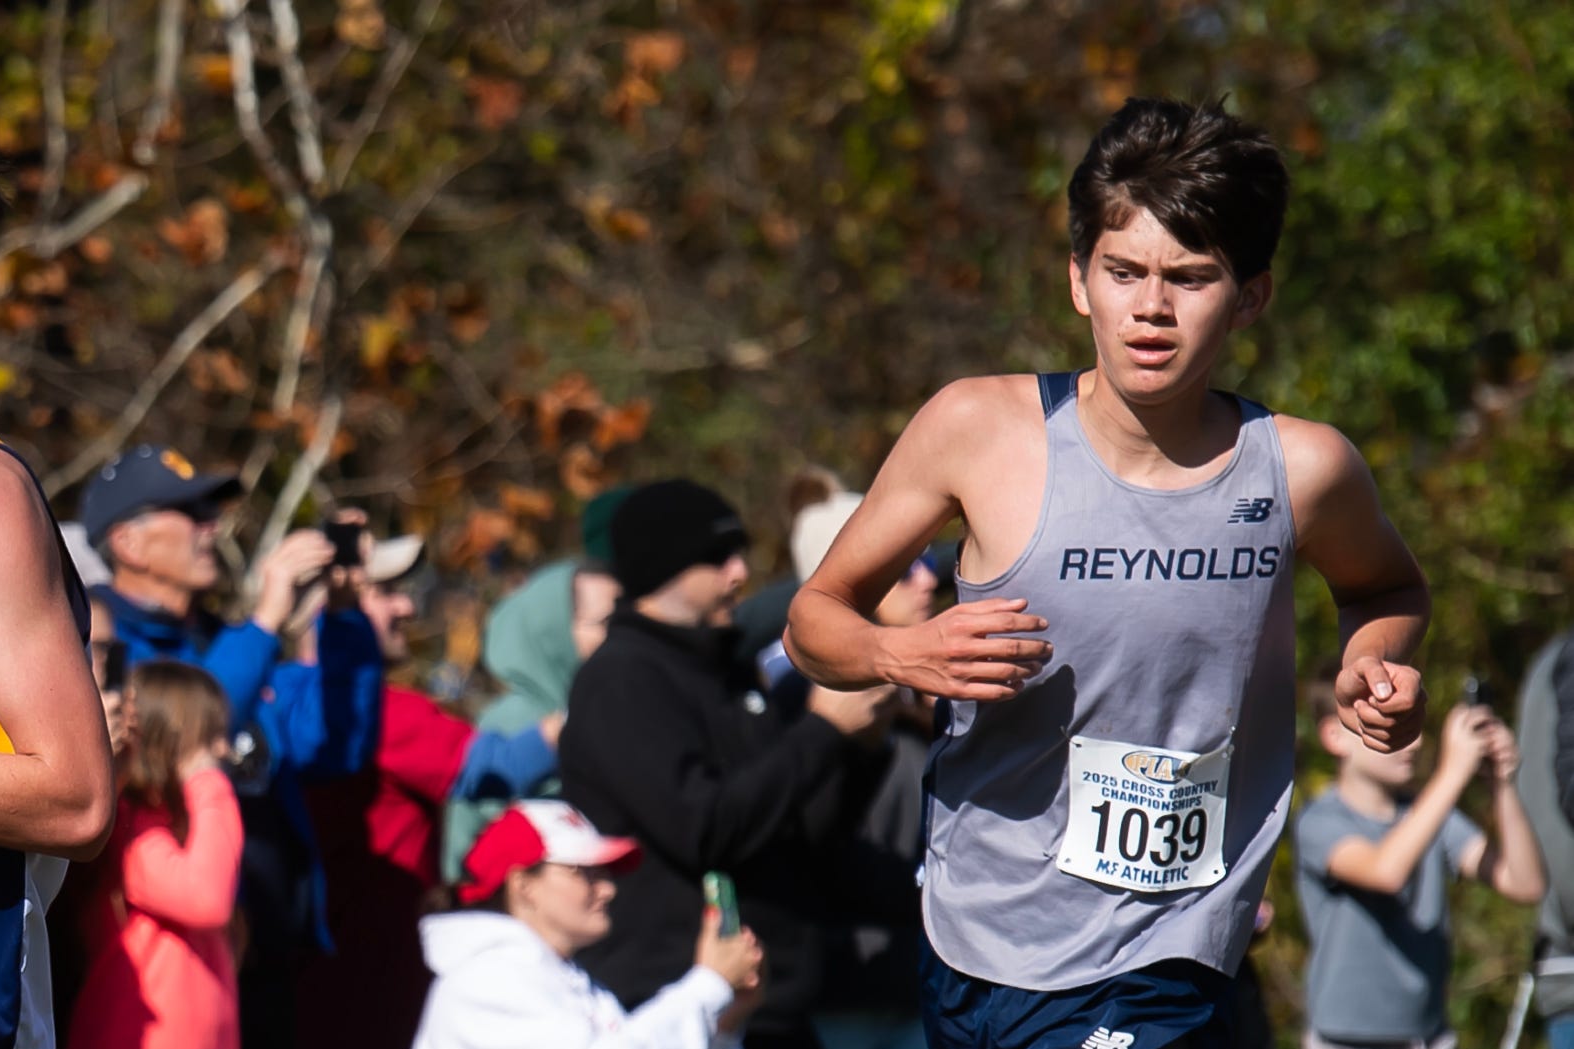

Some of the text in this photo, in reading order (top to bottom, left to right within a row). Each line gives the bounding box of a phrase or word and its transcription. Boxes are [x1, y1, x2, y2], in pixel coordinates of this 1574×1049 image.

[1058, 546, 1281, 582] REYNOLDS
[1082, 771, 1219, 800] 2025 CROSS COUNTRY
[1101, 787, 1202, 811] CHAMPIONSHIPS
[1090, 800, 1208, 868] 1039
[1120, 865, 1189, 885] ATHLETIC
